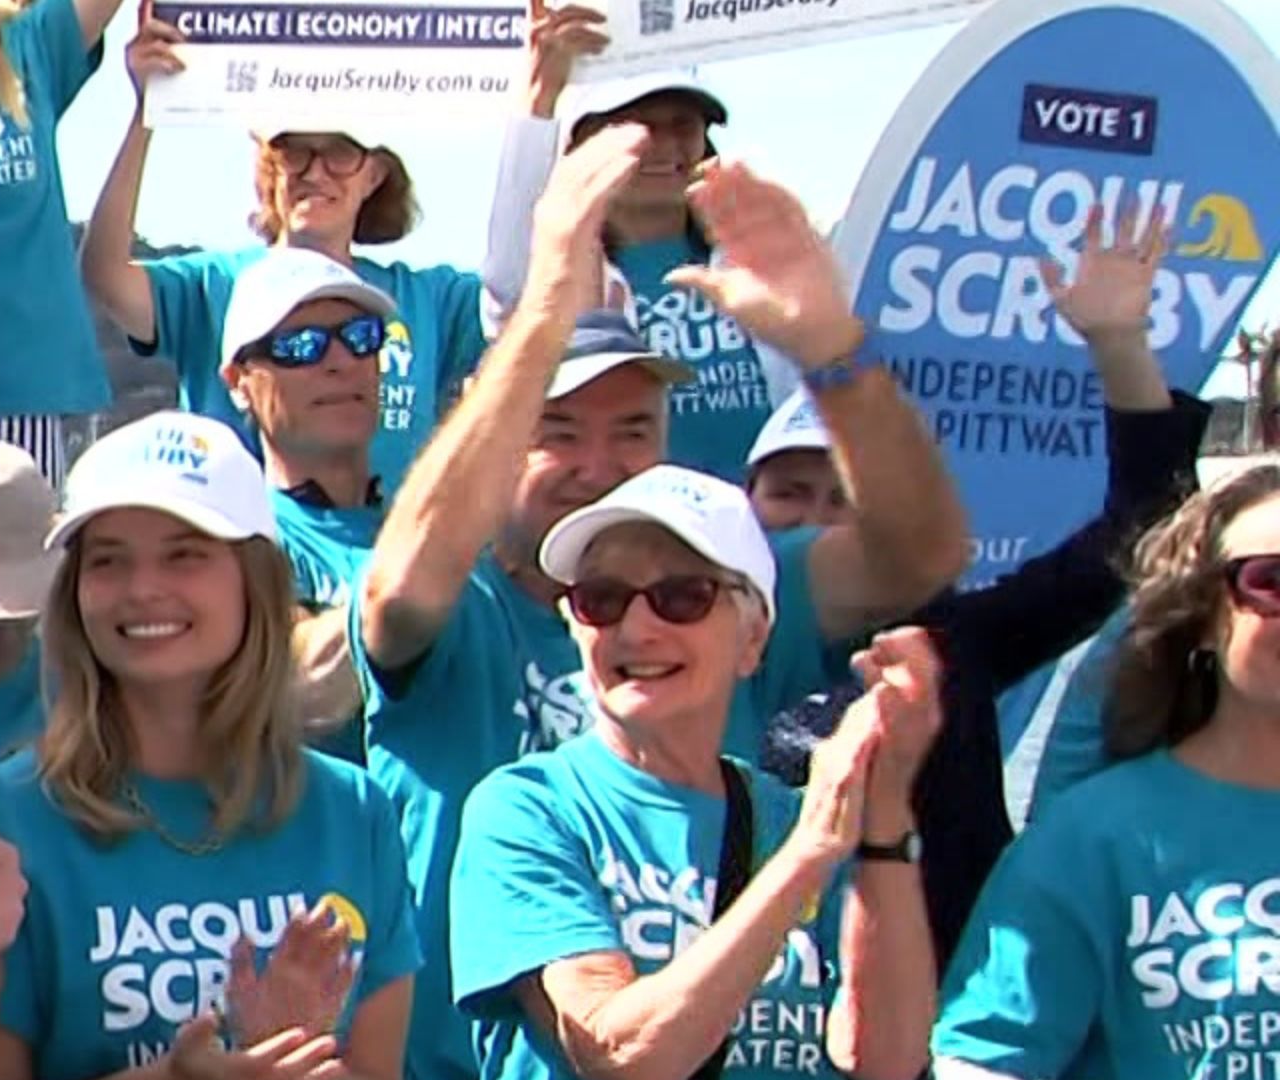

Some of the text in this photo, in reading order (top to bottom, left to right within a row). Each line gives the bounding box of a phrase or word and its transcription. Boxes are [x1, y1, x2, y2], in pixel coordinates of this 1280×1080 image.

[177, 9, 280, 37] CLIMATE
[297, 13, 418, 39] ECONOMY
[1036, 98, 1146, 140] VOTE 1
